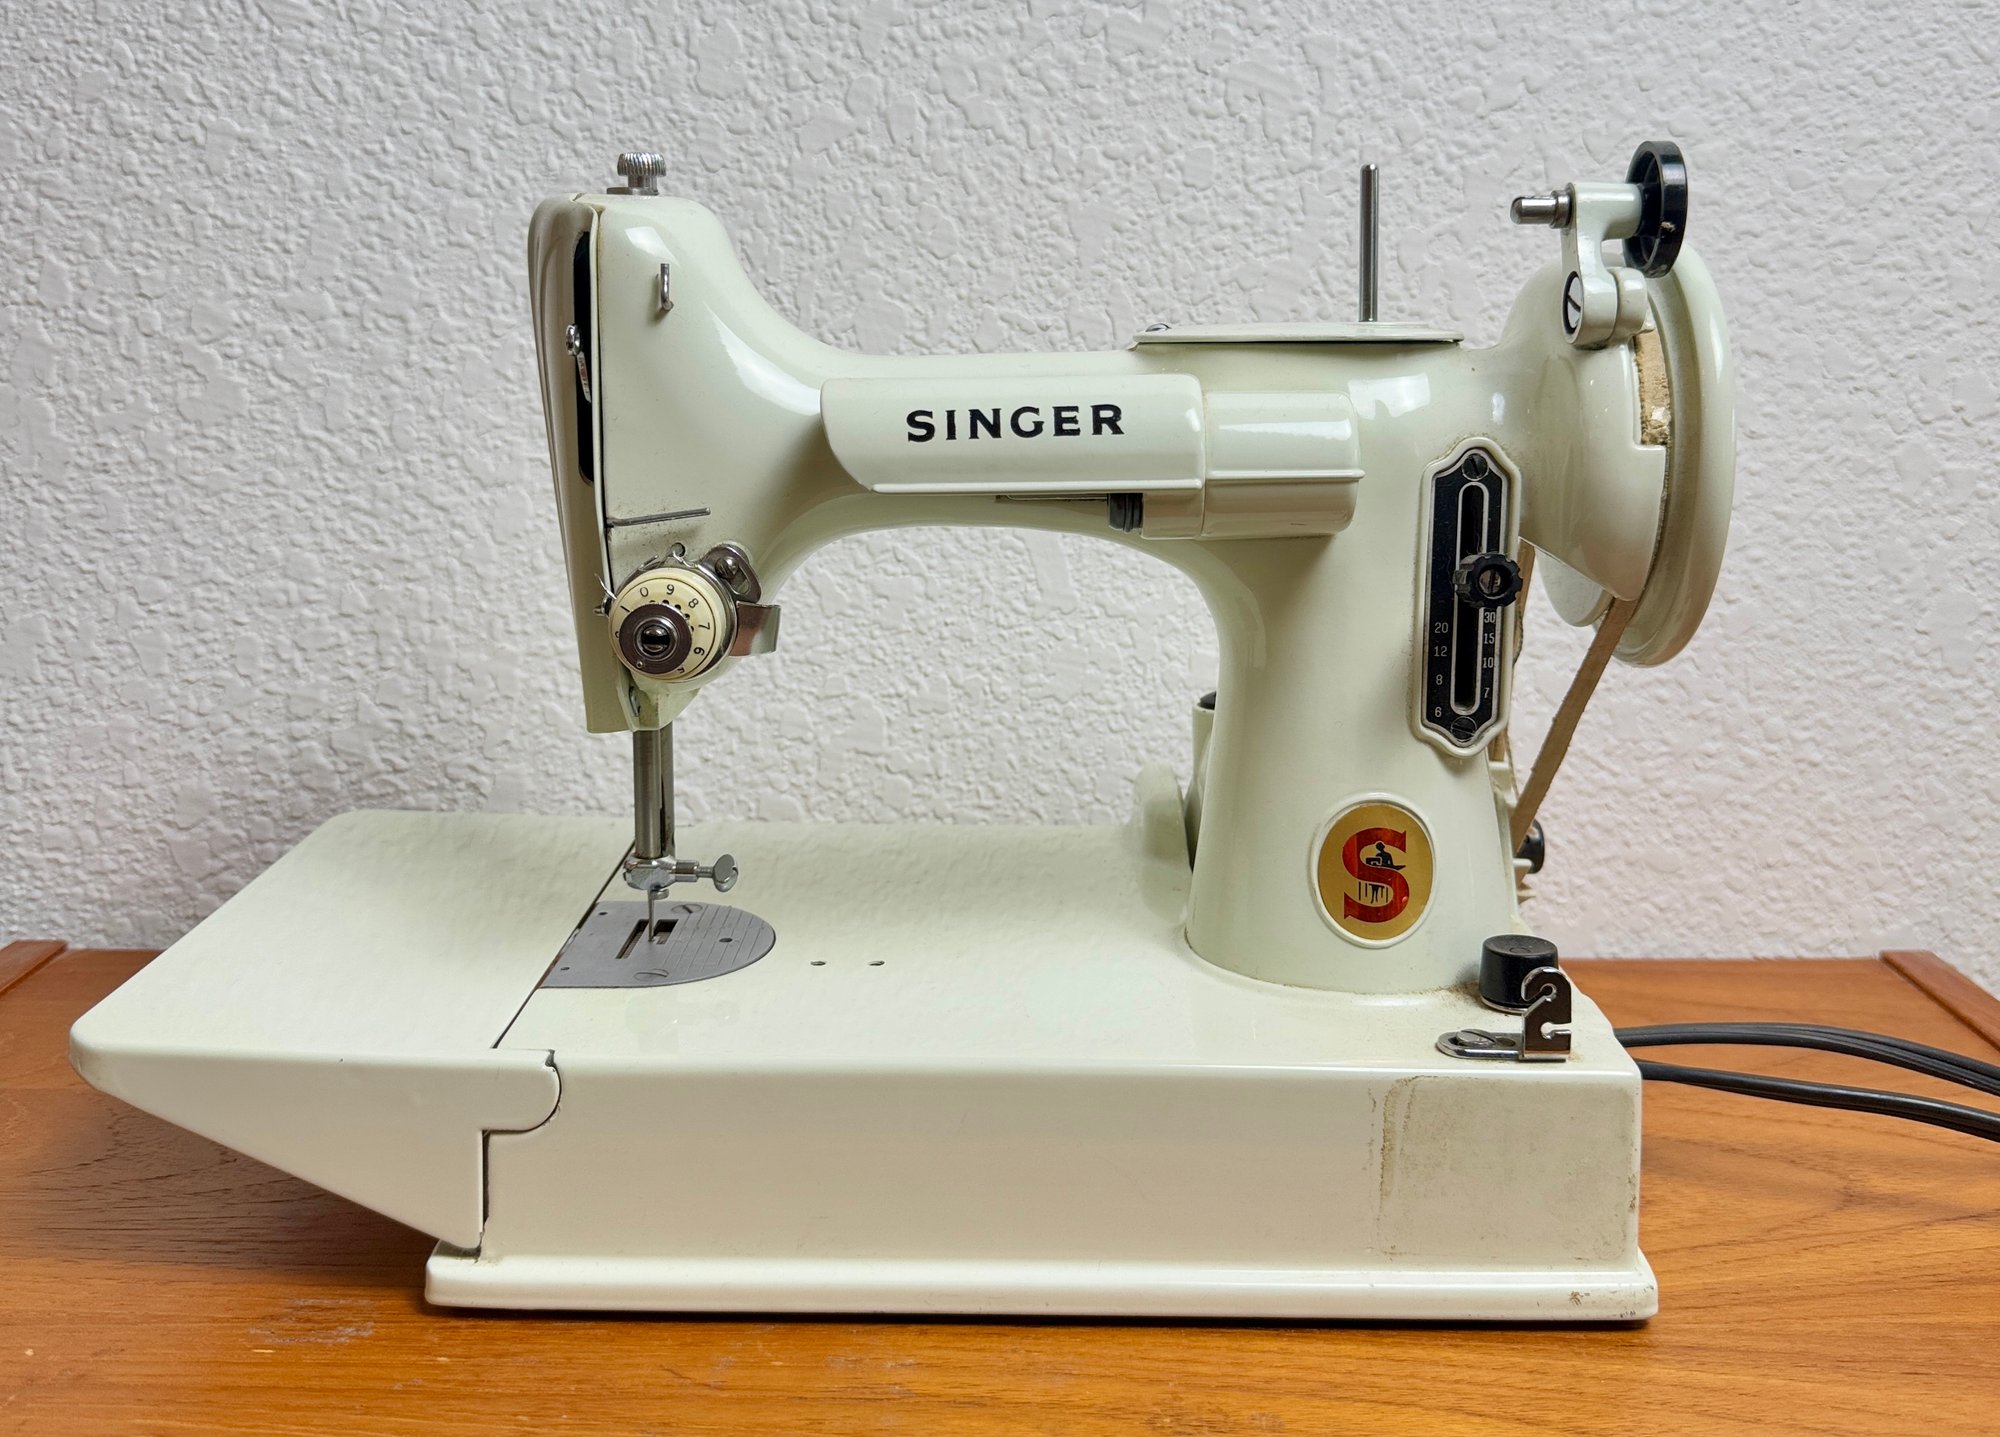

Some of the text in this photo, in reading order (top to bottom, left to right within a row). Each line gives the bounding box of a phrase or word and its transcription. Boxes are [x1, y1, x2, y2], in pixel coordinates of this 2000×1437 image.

[906, 404, 1124, 443] SINGER
[639, 587, 649, 598] 0
[666, 584, 675, 595] 9
[688, 598, 699, 609] 8
[1484, 612, 1496, 623] 30
[698, 622, 711, 630] 7
[1434, 622, 1449, 634] 20
[1484, 633, 1495, 644] 15
[1434, 645, 1448, 657] 12
[1482, 657, 1494, 669] 10
[1435, 674, 1443, 685] 8
[1484, 687, 1490, 698] 7
[1434, 706, 1442, 718] 6
[1342, 827, 1409, 923] S
